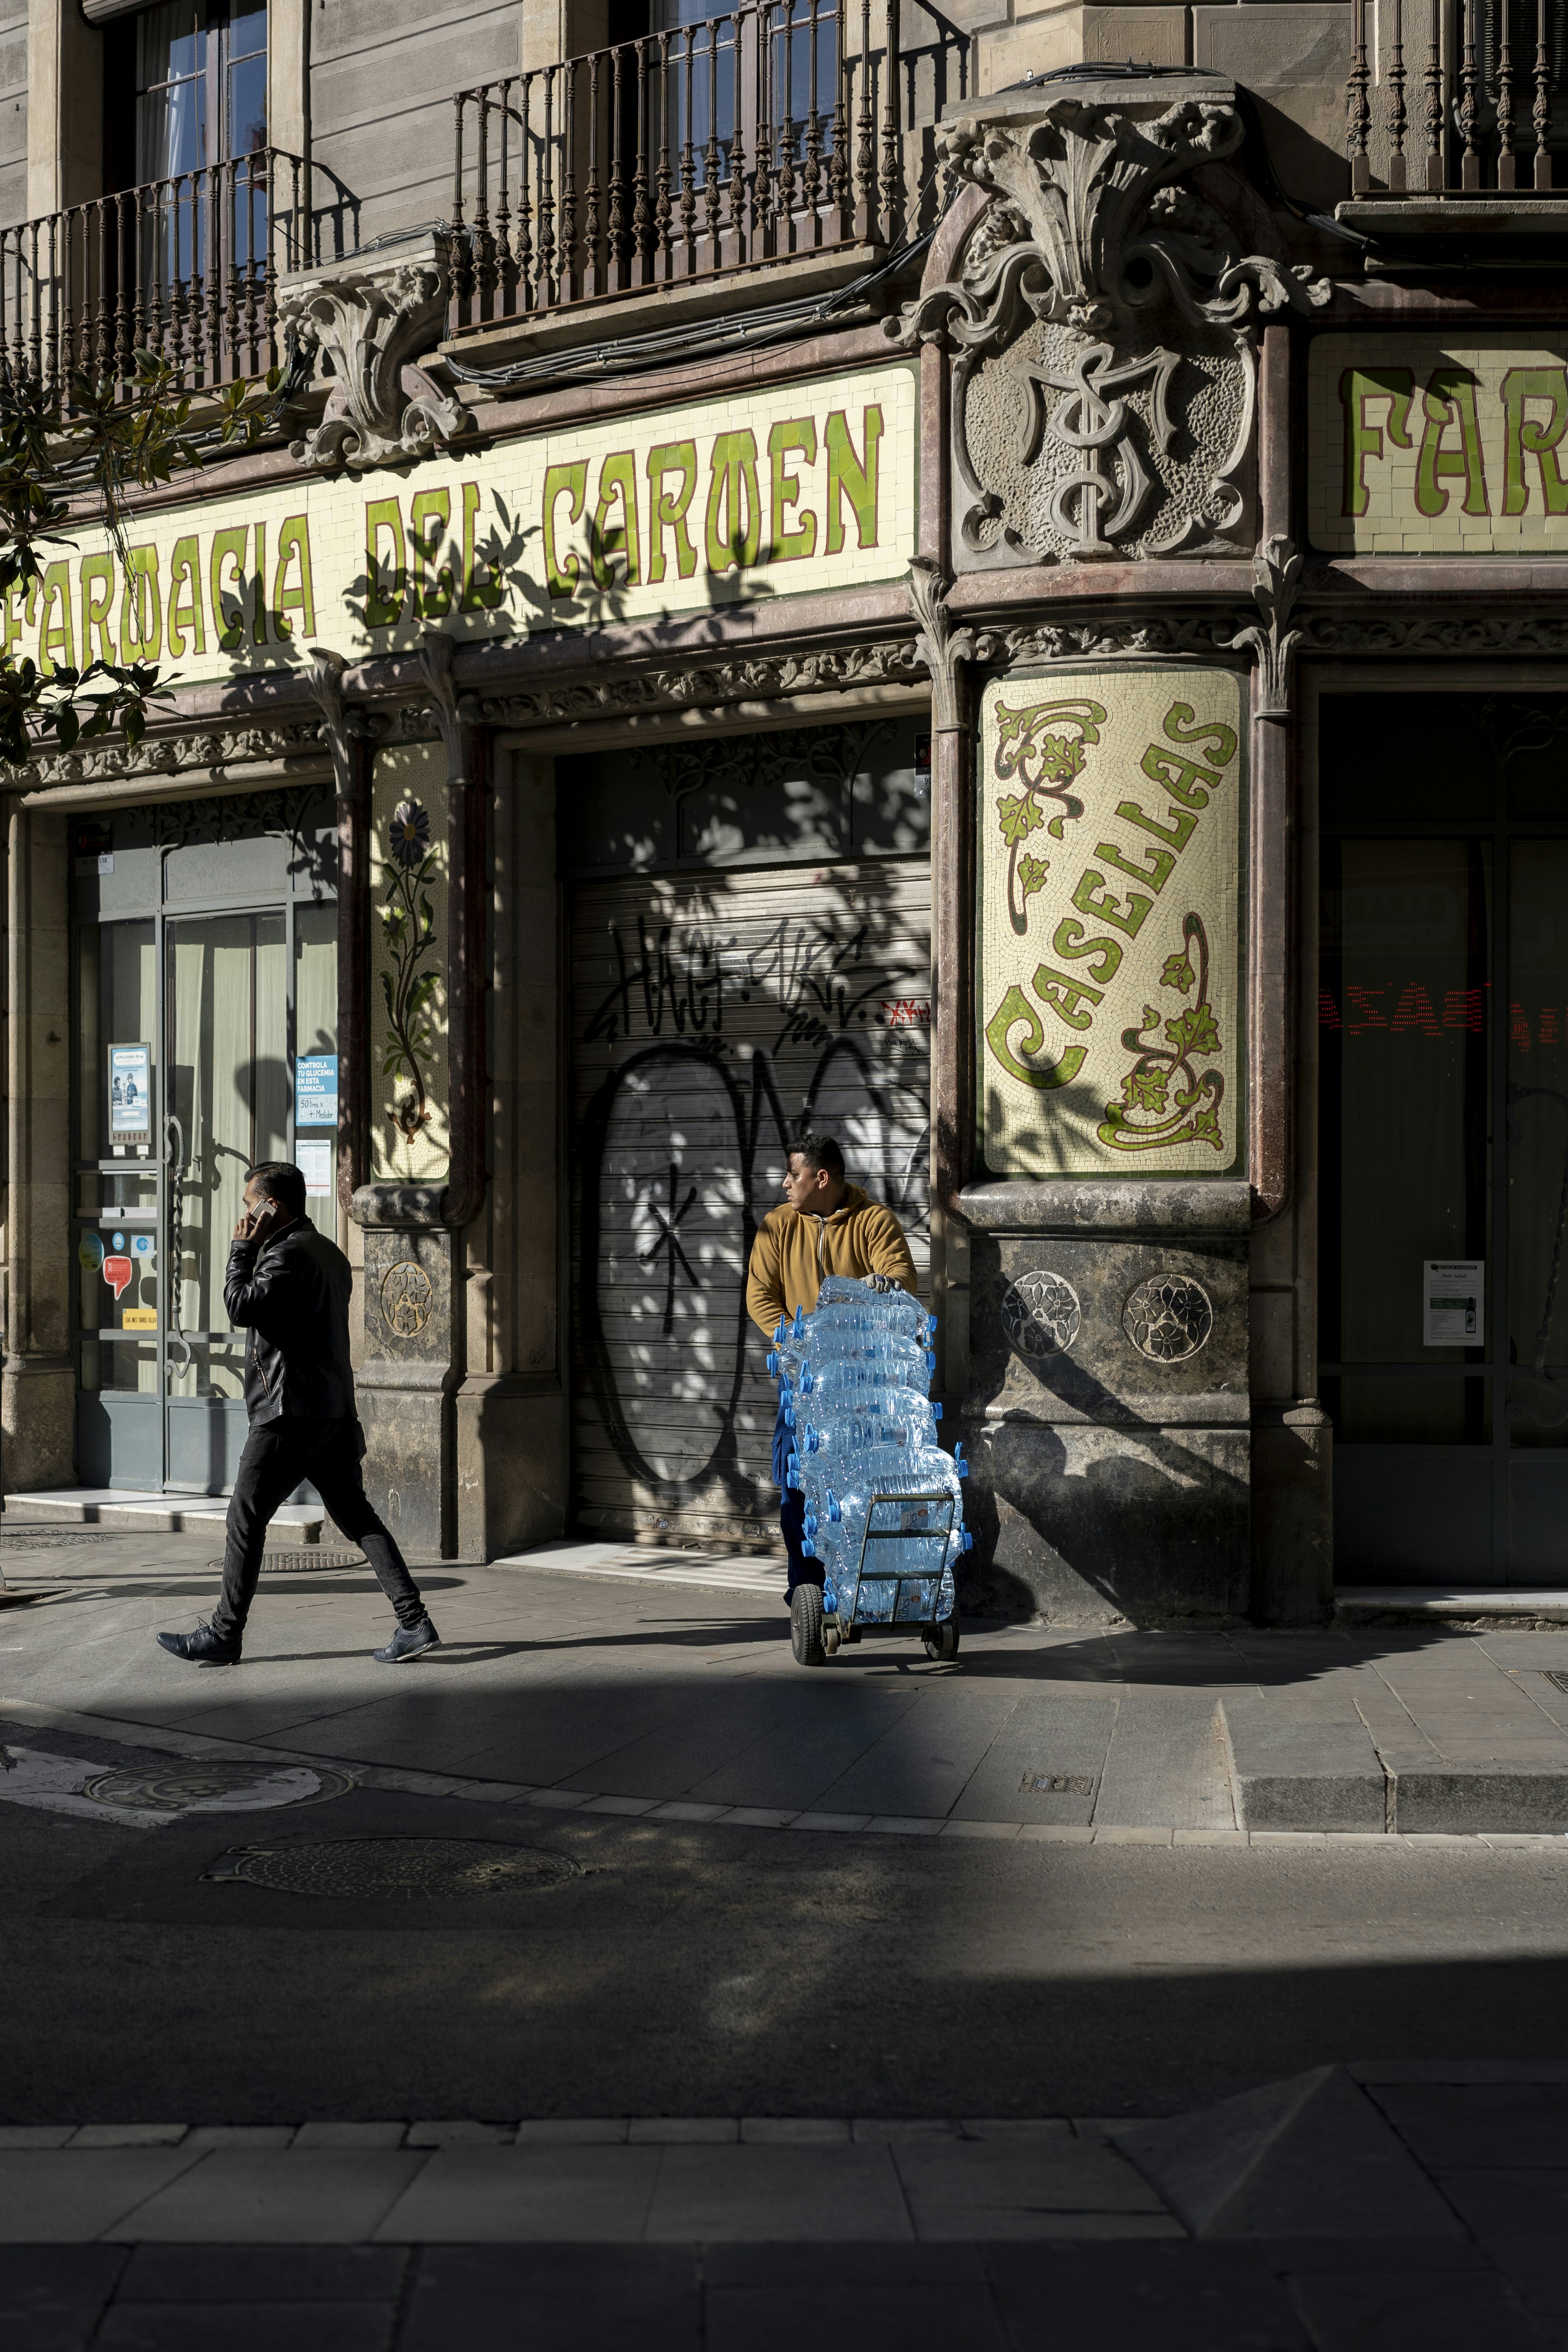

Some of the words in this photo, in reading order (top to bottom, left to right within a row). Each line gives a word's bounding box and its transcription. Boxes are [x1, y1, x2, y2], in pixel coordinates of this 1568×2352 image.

[4, 513, 316, 678] FARMACIA
[362, 481, 503, 630] DEL
[543, 403, 883, 599] CARMEN
[88, 835, 110, 843] COVERT
[985, 701, 1238, 1090] CASELLAS
[301, 1100, 309, 1108] 50
[309, 1099, 319, 1108] tiras
[316, 1109, 334, 1119] Medidor
[897, 1598, 910, 1621] Ribes
